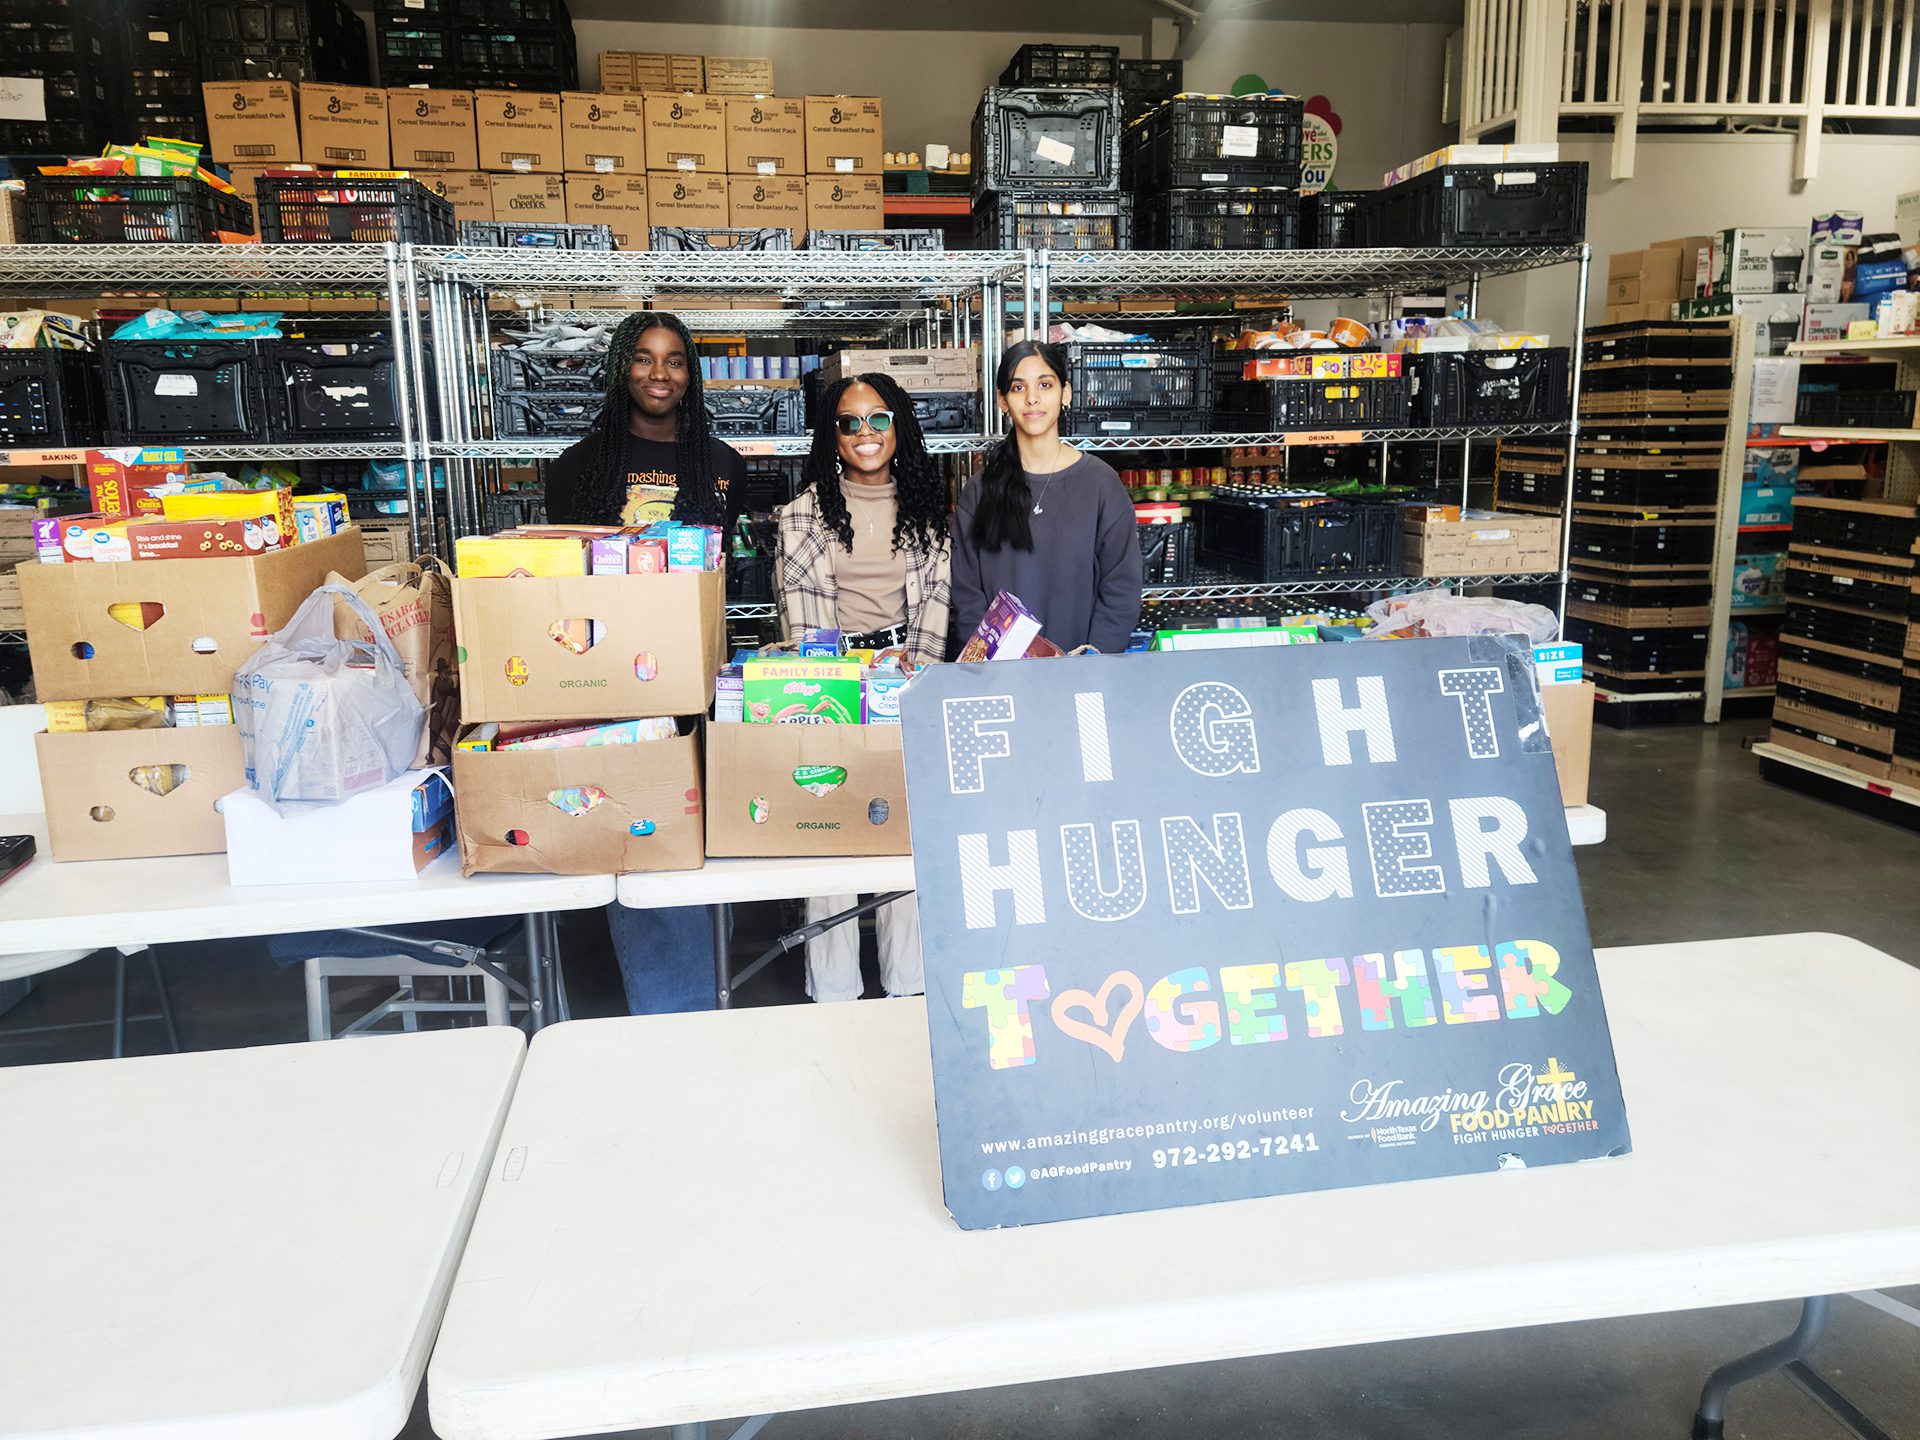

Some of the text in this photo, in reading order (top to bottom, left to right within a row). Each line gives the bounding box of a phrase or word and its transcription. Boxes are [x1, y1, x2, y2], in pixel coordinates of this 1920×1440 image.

[627, 470, 677, 487] mashing
[104, 480, 121, 513] erios
[1539, 650, 1565, 660] SIZE
[763, 667, 842, 677] FAMILY SIZE
[253, 674, 274, 694] Pay
[559, 680, 607, 688] ORGANIC
[784, 682, 822, 696] Kellogg's
[943, 667, 1504, 795] FIGHT
[957, 796, 1539, 930] HUNGER
[1340, 1062, 1588, 1132] Amazing Grace
[980, 1106, 1314, 1154] www.amazinggracepantry.org/volunteer
[1377, 1126, 1397, 1135] North
[1450, 1110, 1510, 1134] FOOD
[1453, 1132, 1487, 1144] FIGHT
[1491, 1127, 1540, 1141] HUNGER
[1152, 1132, 1320, 1169] 972-292-7241
[1030, 1158, 1132, 1180] @AGFoodPantry
